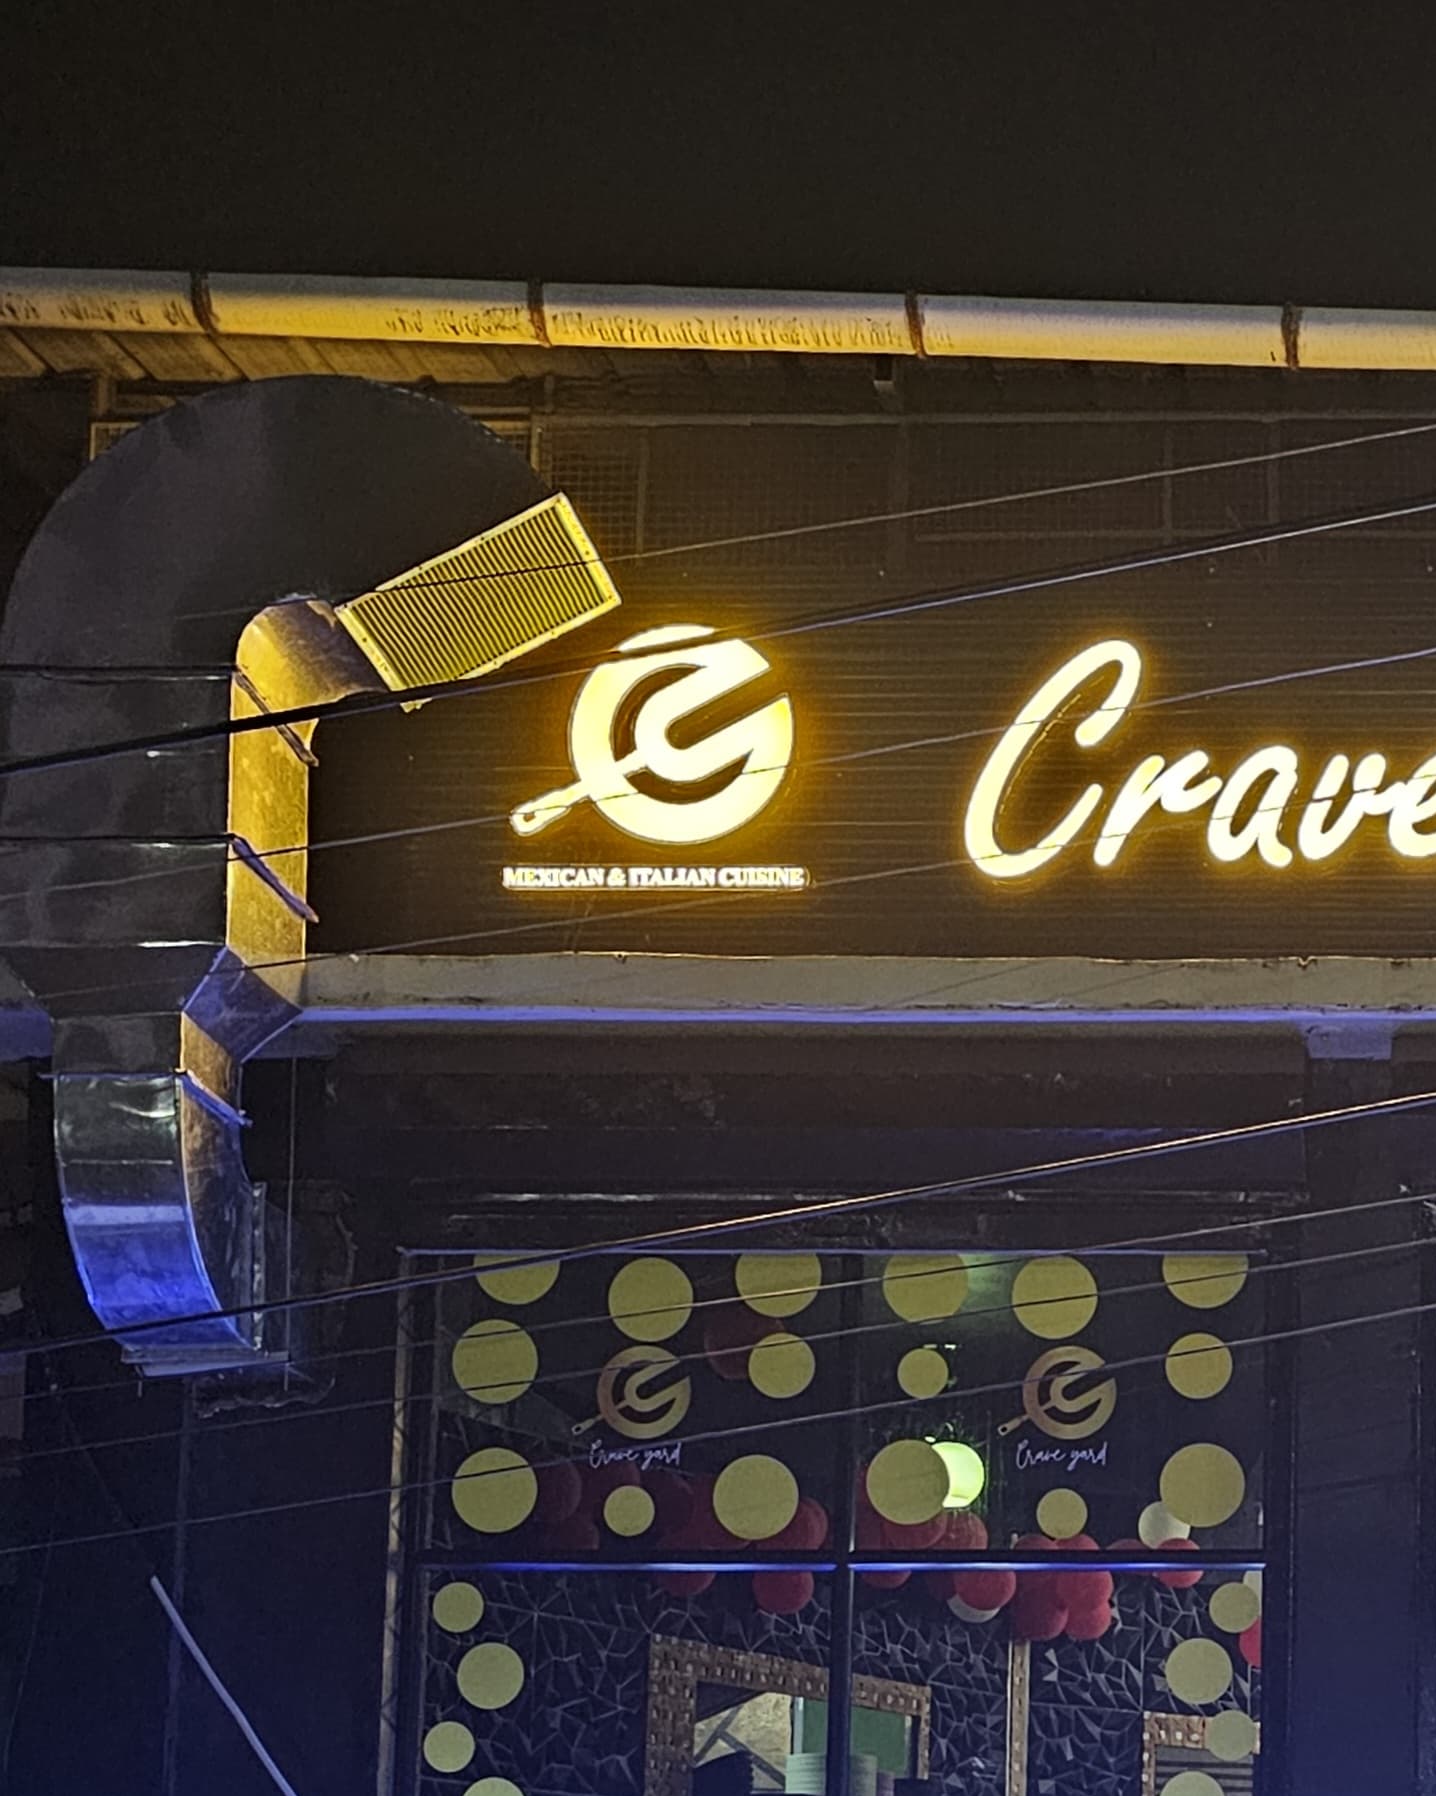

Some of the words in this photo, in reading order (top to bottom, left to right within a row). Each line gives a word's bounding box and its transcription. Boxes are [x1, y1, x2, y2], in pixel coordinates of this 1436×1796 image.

[502, 866, 603, 888] MEXICAN
[606, 866, 627, 888] &
[628, 866, 716, 888] ITALIAN
[717, 866, 806, 889] CUISINE
[1015, 1439, 1067, 1470] Crave
